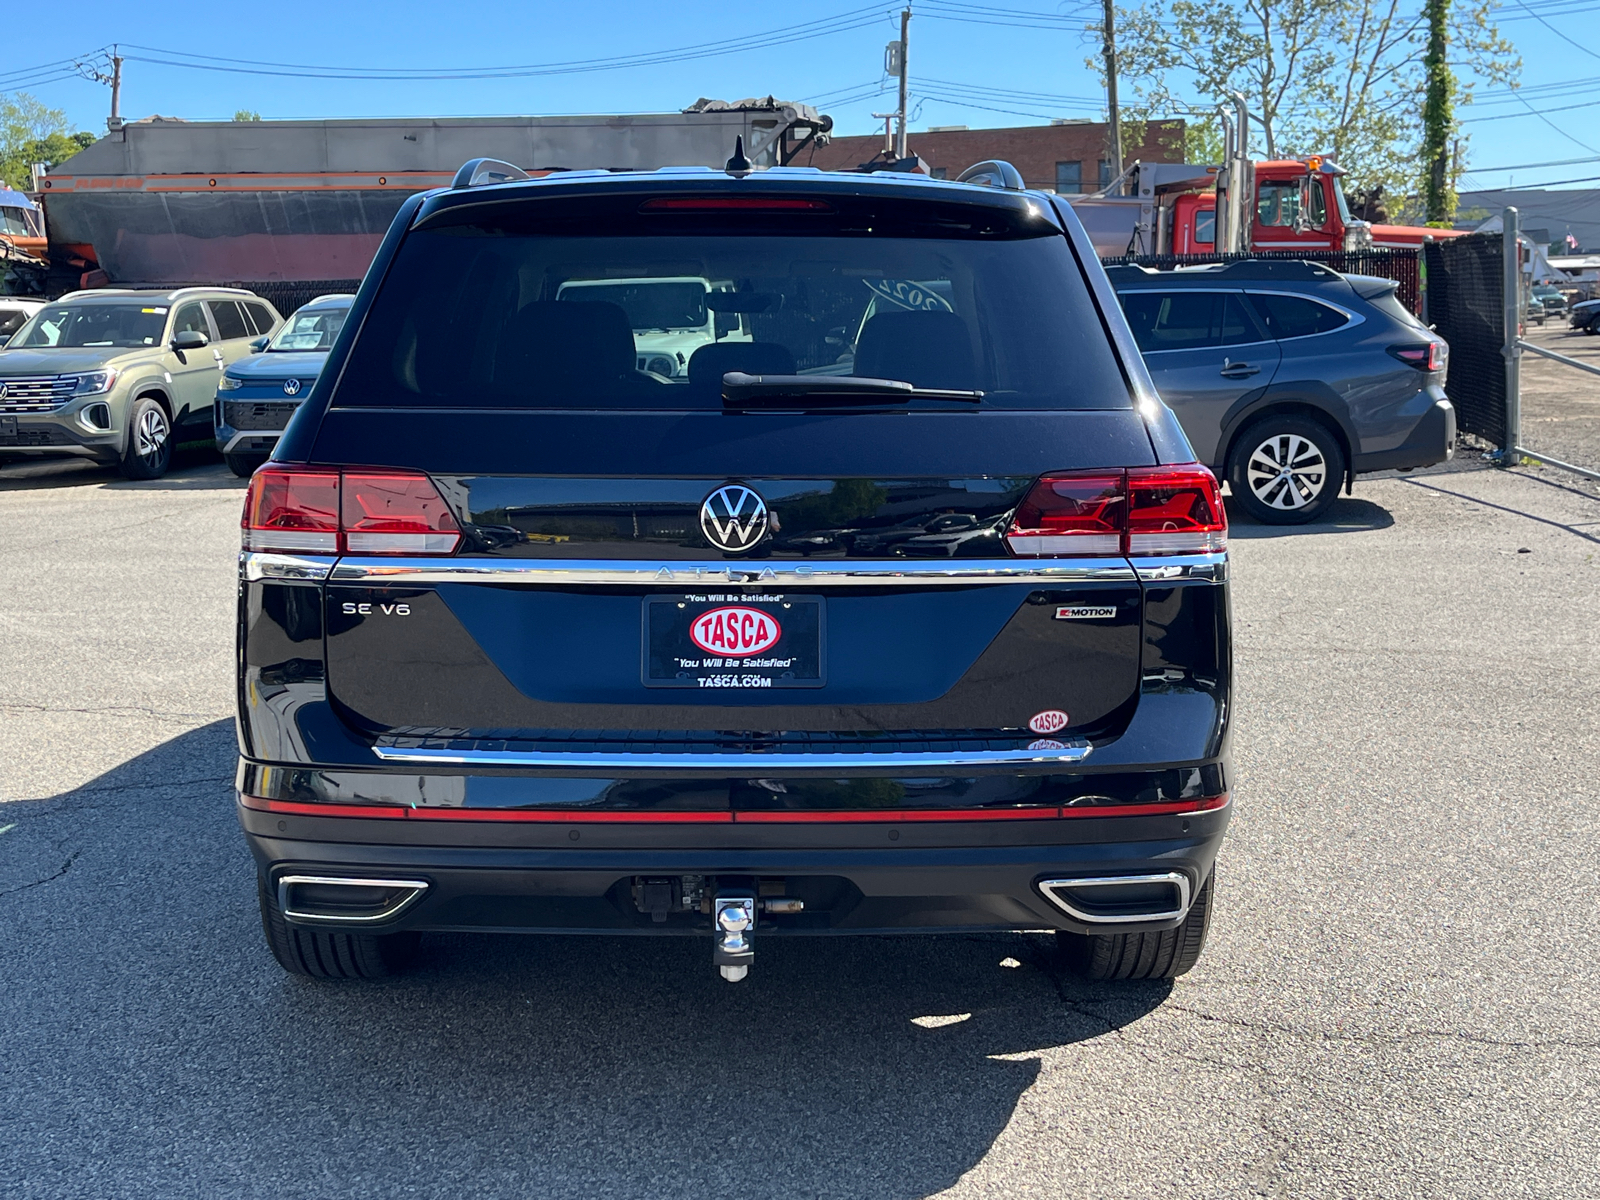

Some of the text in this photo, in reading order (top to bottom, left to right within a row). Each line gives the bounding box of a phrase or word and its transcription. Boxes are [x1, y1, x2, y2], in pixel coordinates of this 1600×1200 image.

[654, 566, 814, 581] ATLAS
[708, 594, 725, 602] Will
[726, 594, 739, 602] Be
[342, 602, 411, 616] SE V6
[701, 612, 769, 649] TASCA
[702, 658, 723, 668] Will
[725, 658, 740, 668] Be
[697, 677, 772, 687] TASCA.COM
[1034, 713, 1064, 730] TASCA
